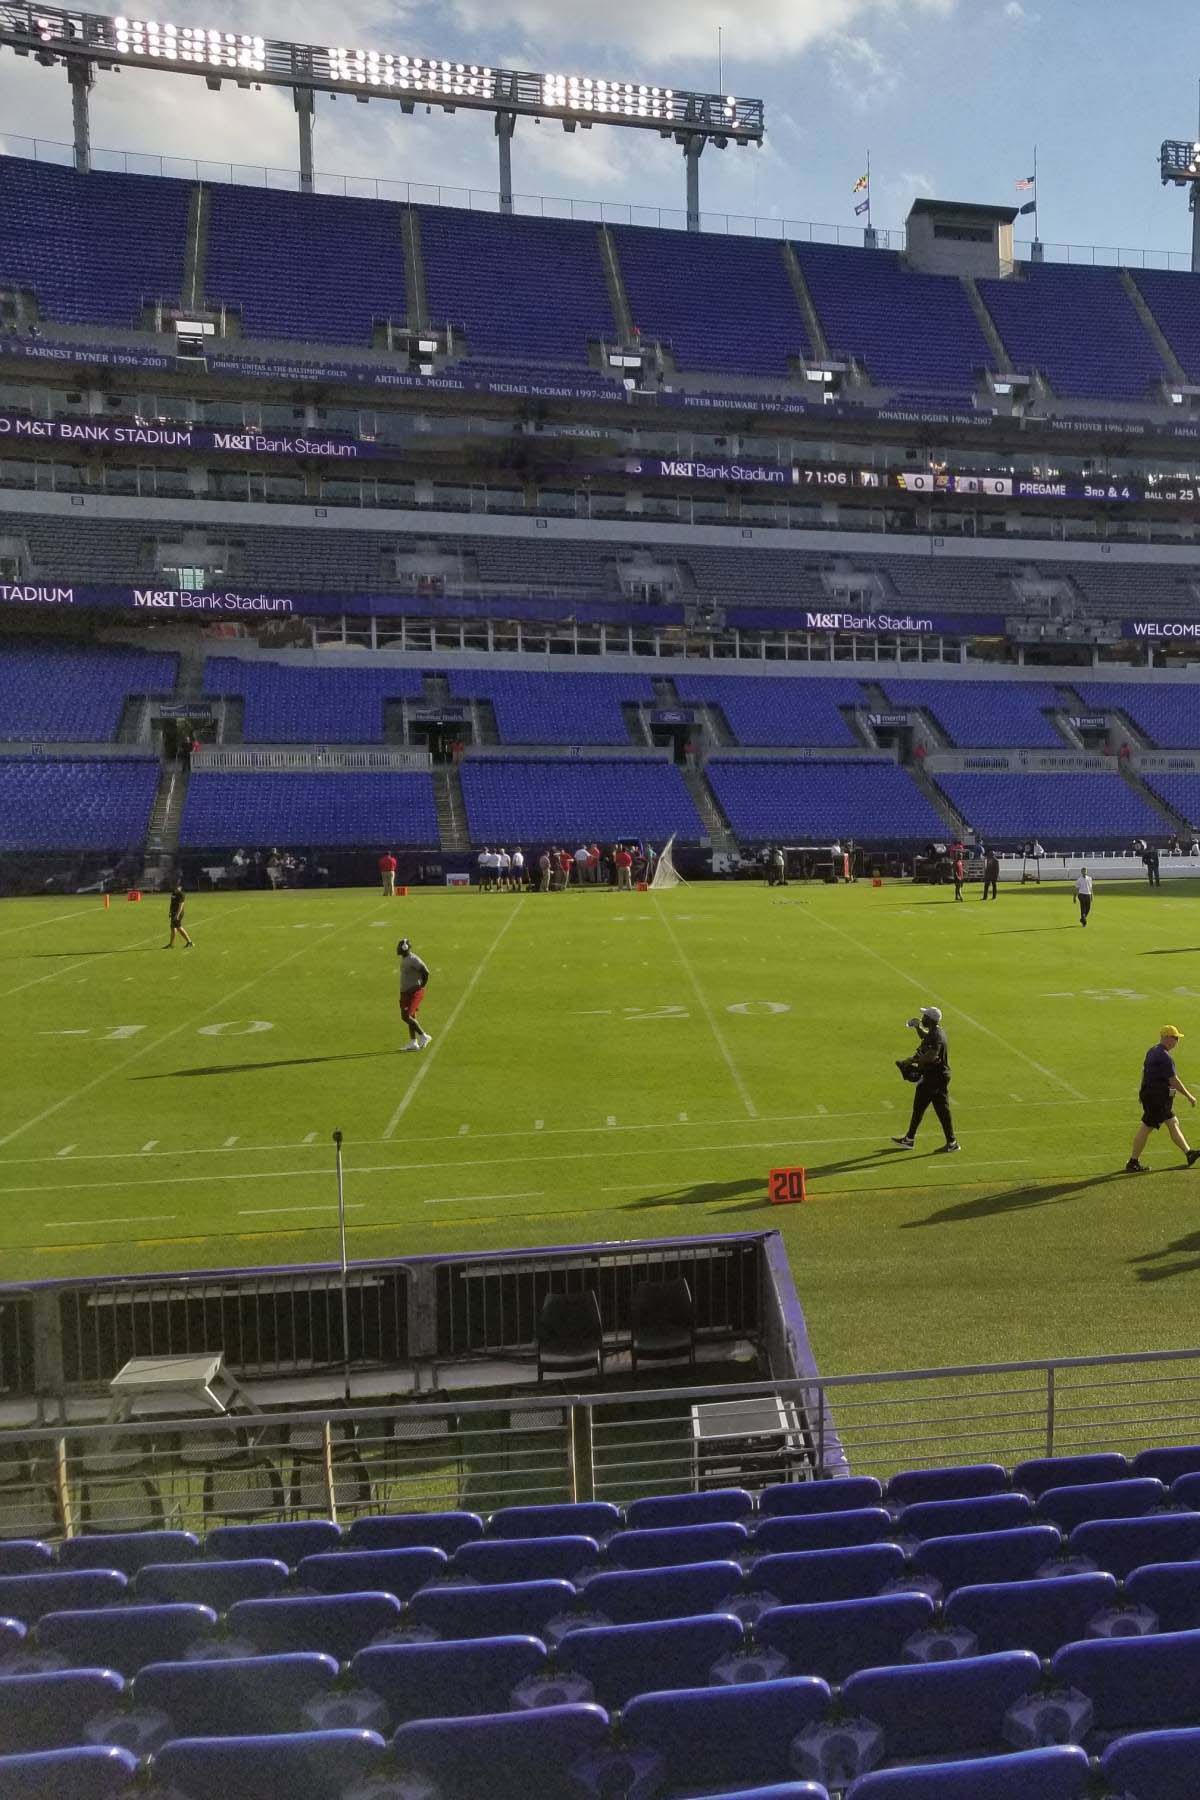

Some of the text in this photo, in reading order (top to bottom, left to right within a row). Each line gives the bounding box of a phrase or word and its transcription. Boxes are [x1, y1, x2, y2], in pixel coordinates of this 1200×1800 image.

[26, 347, 168, 367] EARNEST BYNER 1996-2003
[213, 361, 240, 370] JOHNNY
[242, 363, 266, 371] UNITAS
[274, 365, 287, 373] THE
[288, 367, 327, 376] BALTIMORE
[327, 369, 347, 377] COLTS
[375, 375, 465, 389] ARTHUR B. MODELL
[489, 383, 622, 400] MICHAEL McCRARY 1997-2002
[684, 397, 805, 414] PETER BOULWARE 1997-2005
[877, 410, 993, 426] JONATHAN OGDEN 1996-2007
[16, 420, 56, 435] M&T
[60, 424, 110, 440] BANK
[115, 428, 191, 446] STADIUM
[1052, 421, 1072, 430] MATT
[1073, 422, 1102, 432] STOVER
[213, 433, 357, 456] M&T Bank Stadium
[661, 461, 784, 482] M&T Bank Stadium
[804, 471, 848, 485] 71:06
[914, 477, 925, 489] 0
[994, 481, 1004, 493] 0
[1019, 483, 1066, 496] PREGAME
[1108, 487, 1118, 498] &
[1121, 487, 1130, 498] 4
[1144, 491, 1163, 500] BALL
[1179, 490, 1194, 500] 25
[134, 590, 293, 611] M&T Bank Stadium
[806, 612, 933, 631] M&T Bank Stadium
[774, 1173, 802, 1199] 20
